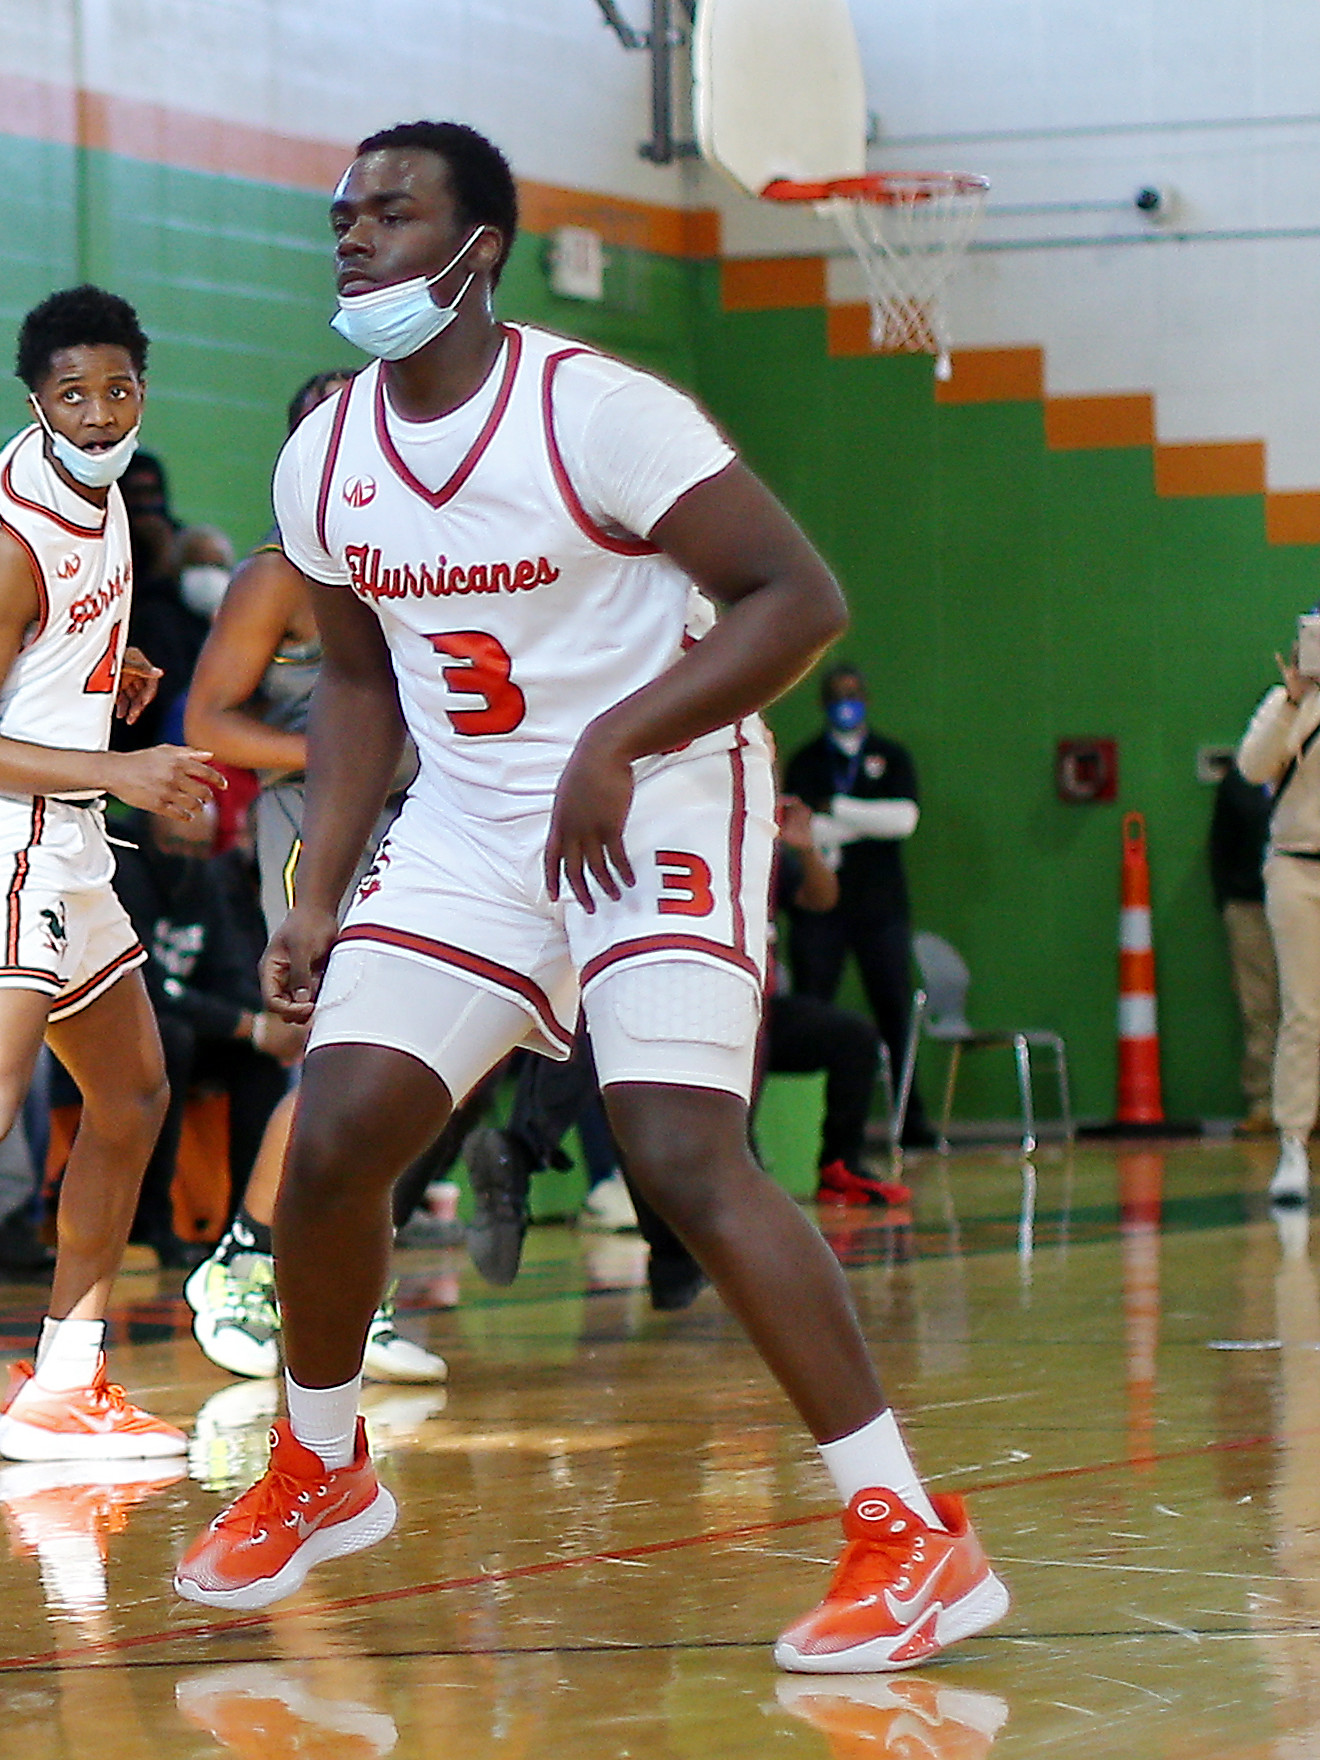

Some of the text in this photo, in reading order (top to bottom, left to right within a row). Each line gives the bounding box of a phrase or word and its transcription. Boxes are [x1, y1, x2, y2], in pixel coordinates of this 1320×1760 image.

[344, 543, 560, 602] Hurricanes
[83, 620, 121, 694] 4
[420, 630, 526, 735] 3
[655, 850, 714, 917] 3
